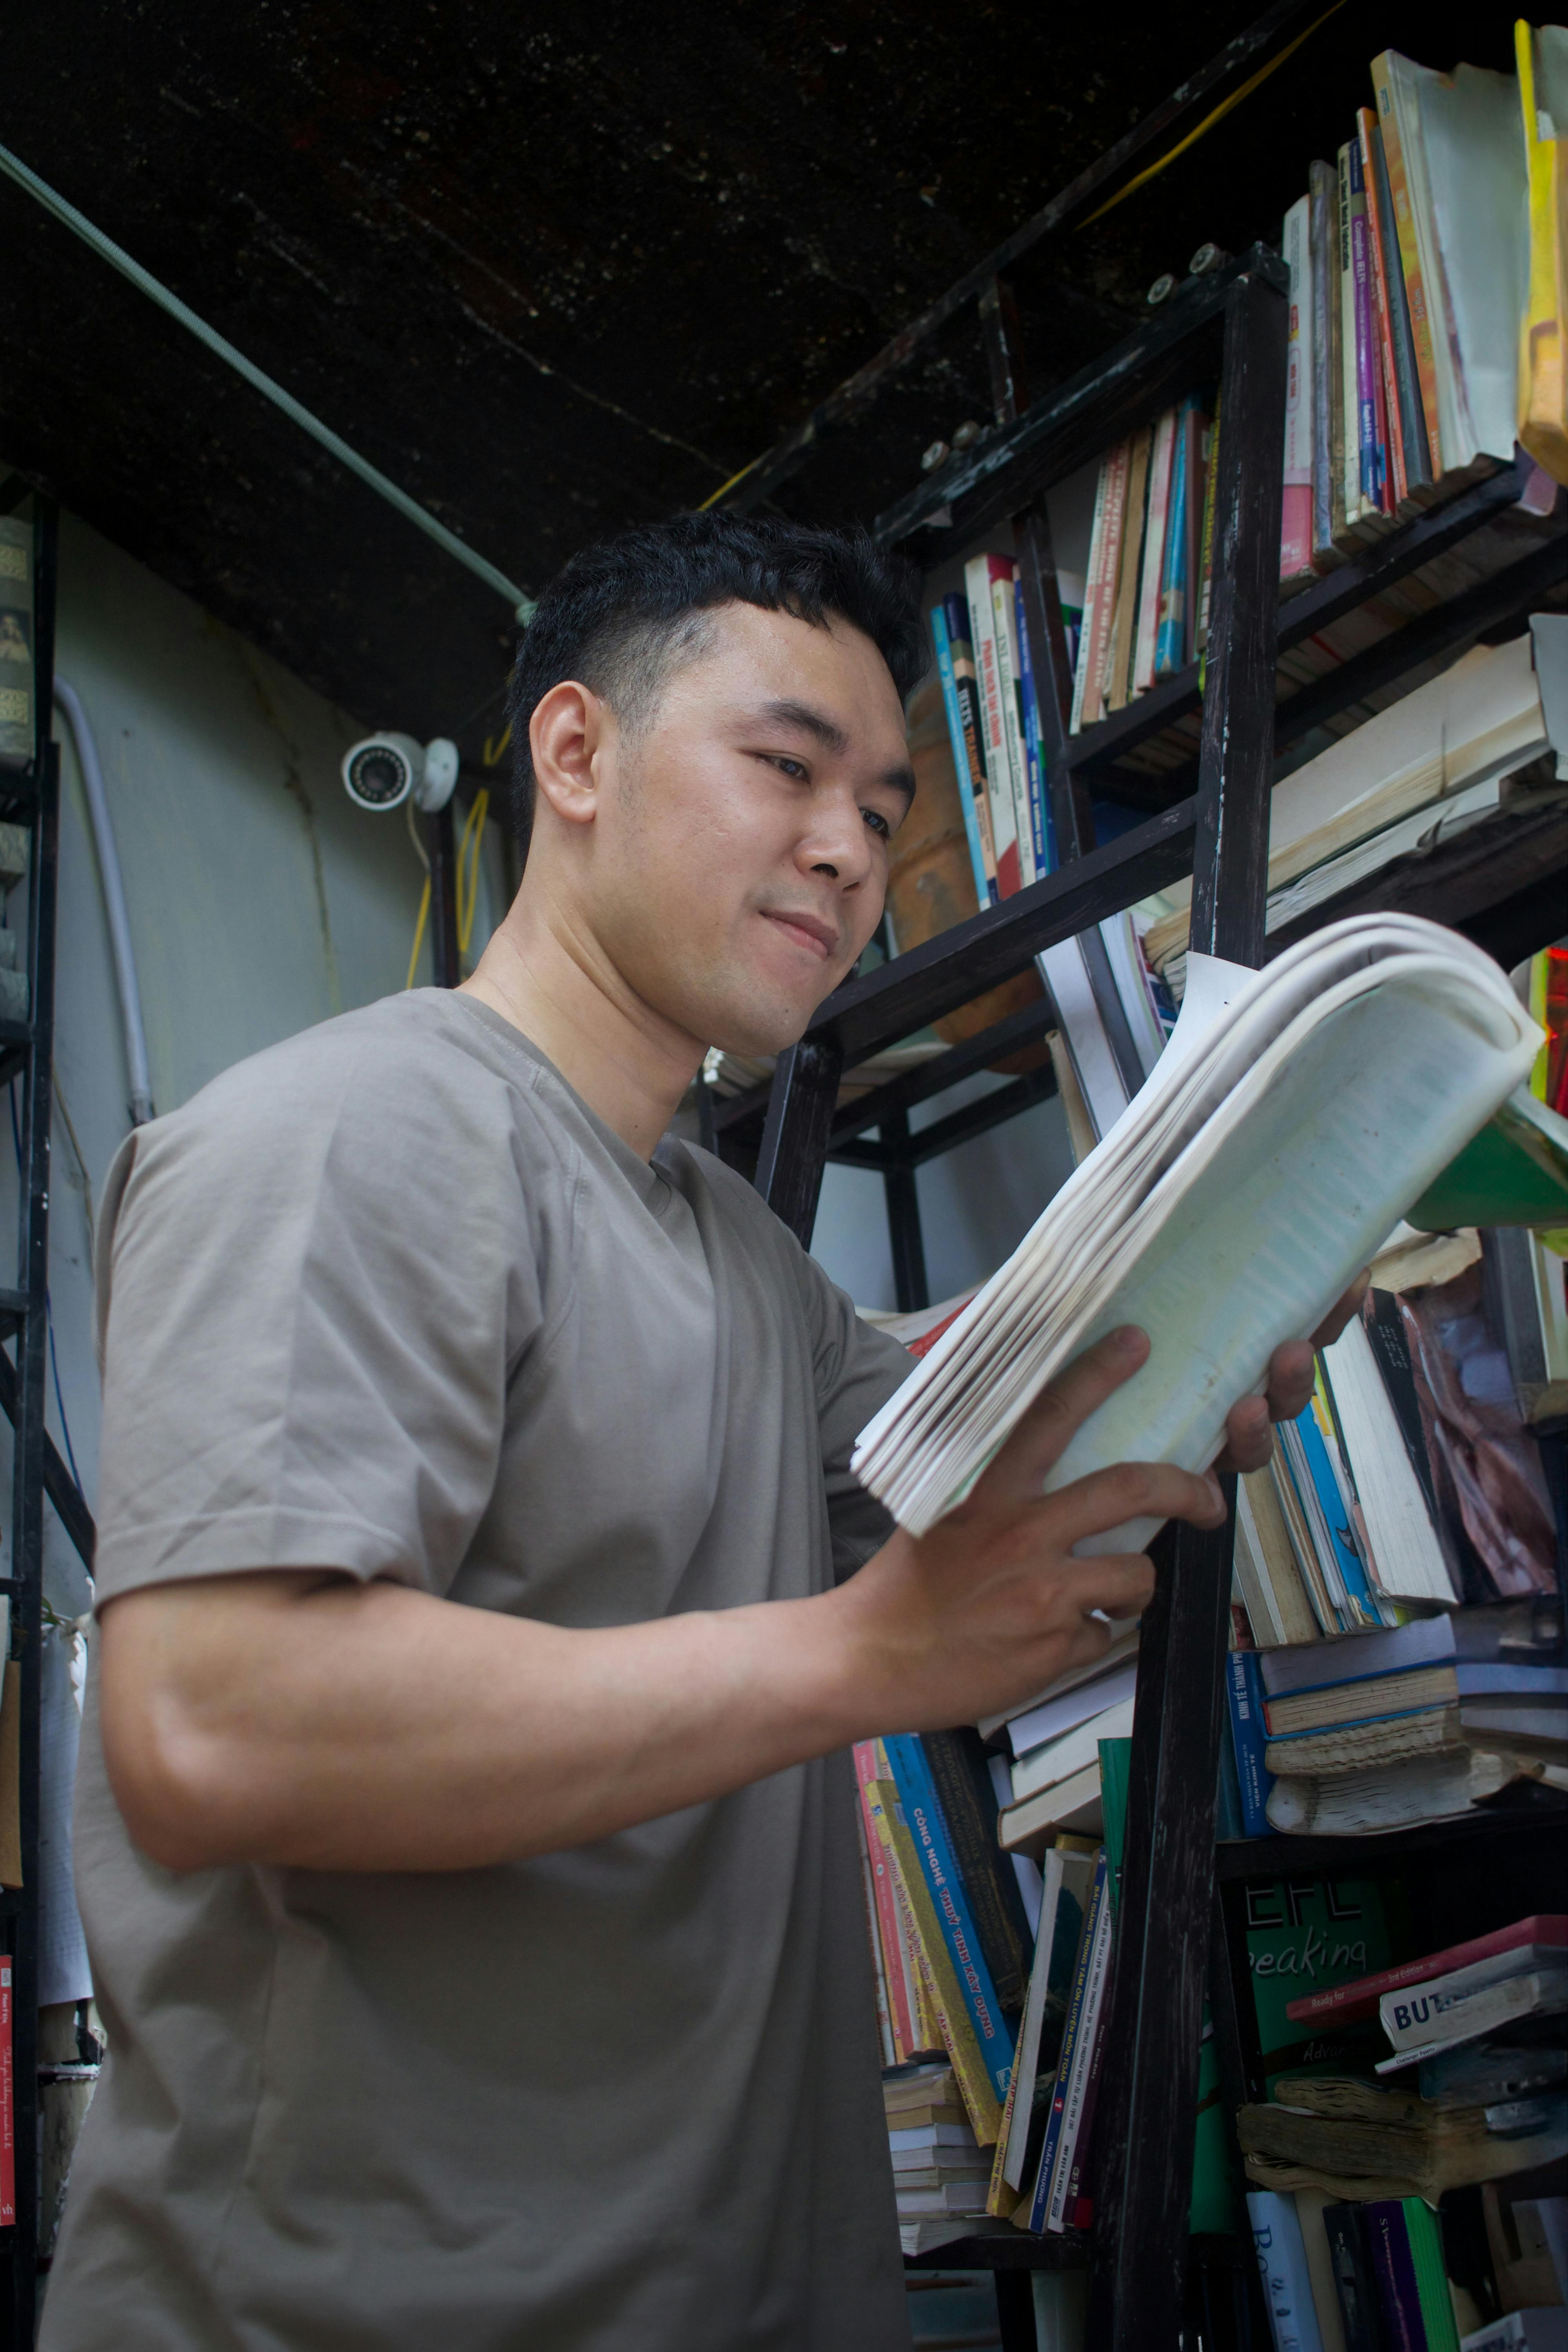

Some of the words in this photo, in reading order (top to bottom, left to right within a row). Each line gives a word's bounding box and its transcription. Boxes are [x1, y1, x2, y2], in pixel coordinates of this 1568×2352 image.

[1354, 221, 1364, 260] Complete
[1357, 262, 1366, 283] IELTS
[959, 690, 973, 724] IELTS
[1007, 711, 1017, 765] Introductory
[965, 725, 982, 784] TRAINER
[1230, 1664, 1247, 1690] THÀNH
[1232, 1690, 1247, 1701] TẾ
[1240, 1701, 1250, 1720] KINH
[1249, 1753, 1256, 1765] TẾ
[1253, 1788, 1262, 1808] VIỆN
[884, 1844, 899, 1882] NHỮNG
[896, 1884, 906, 1902] BÀI
[911, 1929, 922, 1954] VĂN
[1091, 1885, 1102, 1901] BÀI
[913, 1807, 931, 1847] CÔNG
[926, 1848, 946, 1886] NGHỆ
[938, 1887, 961, 1926] THUỶ
[952, 1929, 971, 1962] TINH
[963, 1964, 983, 1995] XÂY
[973, 1996, 994, 2039] DỰNG
[1085, 1902, 1099, 1932] GIẢNG
[1079, 1933, 1093, 1964] TRỌNG
[1094, 1957, 1102, 1969] BẤT
[1076, 1965, 1087, 1986] TÂM
[1073, 1987, 1083, 2001] ÔN
[1312, 1996, 1333, 2009] Ready
[1334, 1991, 1345, 2000] for
[1388, 1972, 1398, 1982] 3rd
[1400, 1964, 1423, 1978] Edition
[1086, 1990, 1098, 2013] PHƯƠNG
[1067, 2002, 1082, 2033] LUYỆN
[1085, 2015, 1093, 2024] HỆ
[934, 2009, 949, 2032] TẬP
[942, 2031, 956, 2053] HAI
[1082, 2025, 1092, 2044] TRÌNH,
[1063, 2034, 1075, 2056] MÔN
[1077, 2045, 1089, 2069] PHƯƠNG
[1396, 2054, 1419, 2065] Challenger
[1420, 2047, 1436, 2056] Palette
[1058, 2057, 1071, 2083] TOÁN
[1074, 2070, 1084, 2085] LUẬN
[1073, 2086, 1081, 2094] TỰ
[1001, 2099, 1016, 2120] HAI
[1054, 2100, 1063, 2108] 1
[1071, 2095, 1080, 2107] TẬP
[996, 2141, 1007, 2161] TRẦN
[1043, 2140, 1055, 2165] TRẦN
[1062, 2144, 1070, 2156] ANH
[1035, 2165, 1051, 2203] PHƯƠNG
[1058, 2169, 1066, 2179] THỊ
[1054, 2179, 1064, 2194] TRẦN
[2, 2203, 13, 2214] vh
